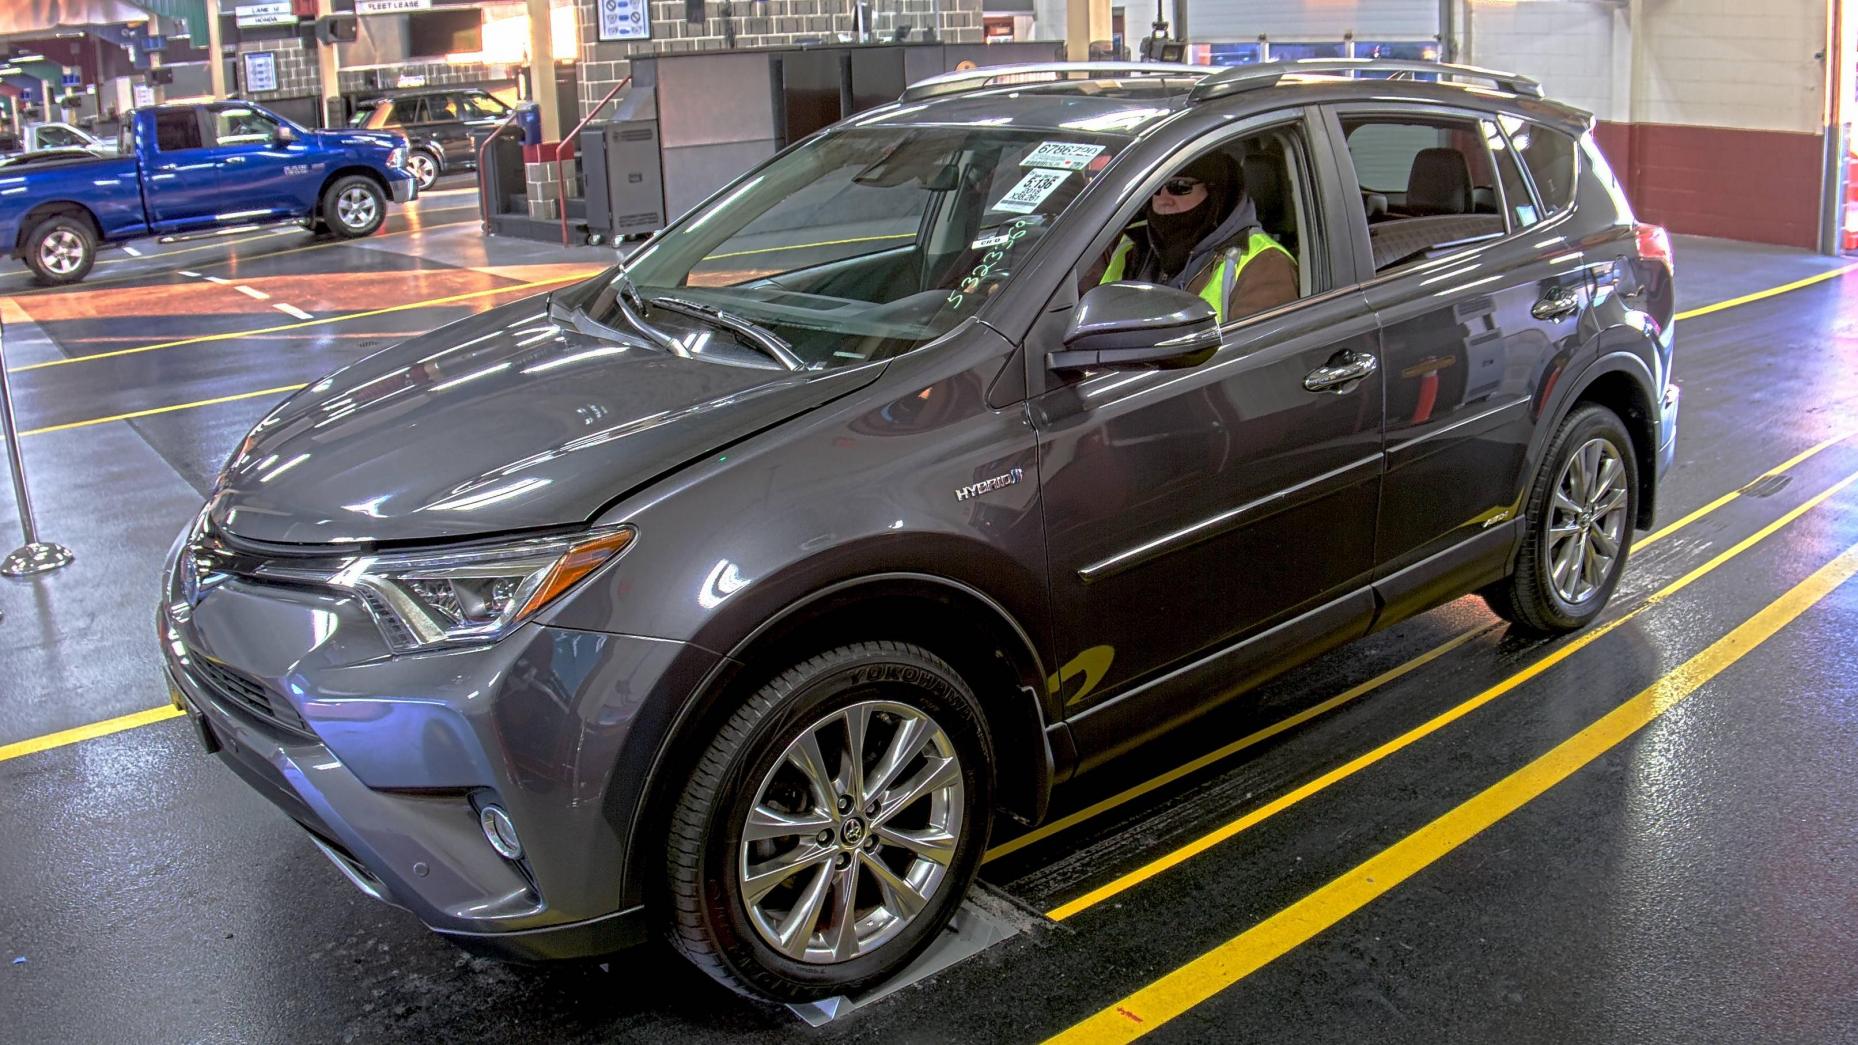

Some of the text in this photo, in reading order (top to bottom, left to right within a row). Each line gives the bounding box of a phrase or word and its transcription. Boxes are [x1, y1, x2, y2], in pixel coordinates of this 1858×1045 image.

[367, 1, 420, 10] FLEET LEASE
[955, 473, 1012, 501] HYBRID
[850, 662, 975, 721] YOKOHAMA
